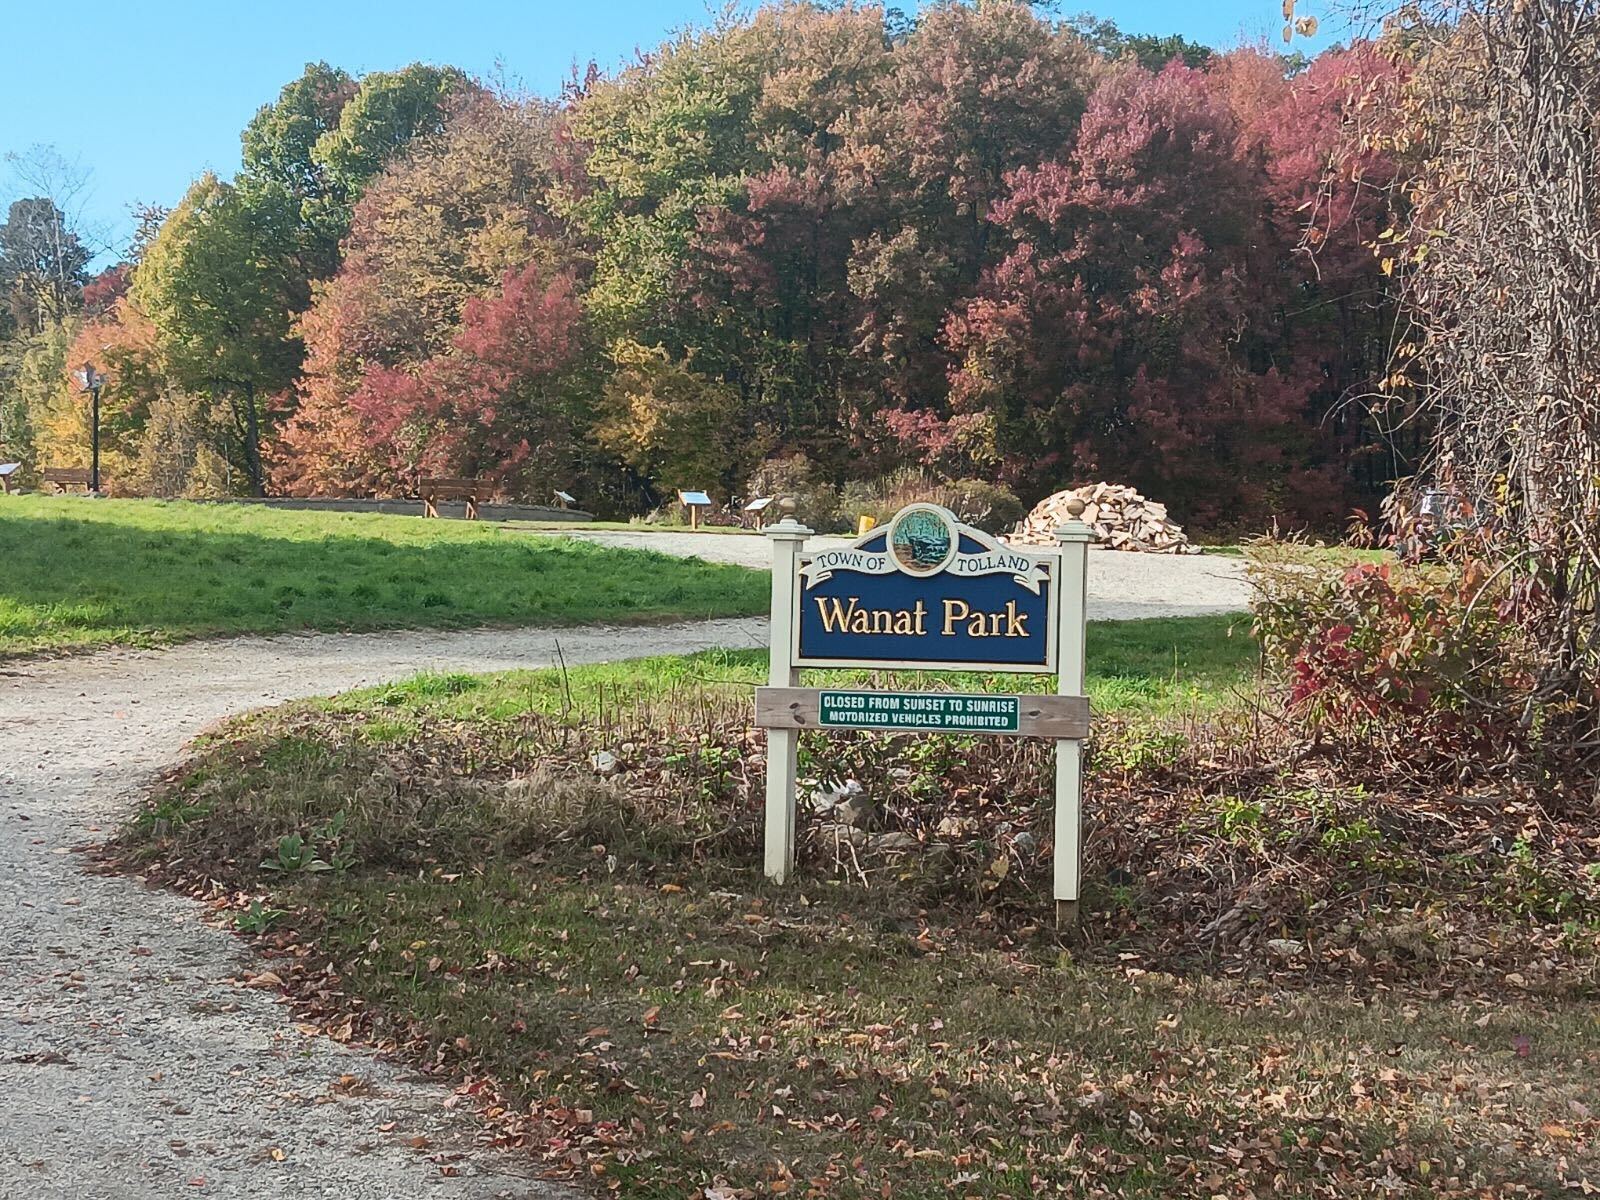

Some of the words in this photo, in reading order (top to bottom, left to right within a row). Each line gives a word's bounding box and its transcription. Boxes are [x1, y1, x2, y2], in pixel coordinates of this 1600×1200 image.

[817, 552, 863, 569] TOWN
[867, 557, 886, 571] OF
[957, 555, 1030, 572] TOLLAND
[814, 597, 928, 636] Wanat
[941, 599, 1030, 637] Park
[824, 696, 865, 709] CLOSED
[869, 698, 900, 710] FROM
[903, 698, 946, 711] SUNSET
[949, 699, 963, 712] TO
[966, 700, 1015, 713] SUNRISE
[829, 711, 889, 723] MOTORIZED
[892, 713, 942, 725] VEHICLES
[945, 714, 1009, 727] PROHIBITED
